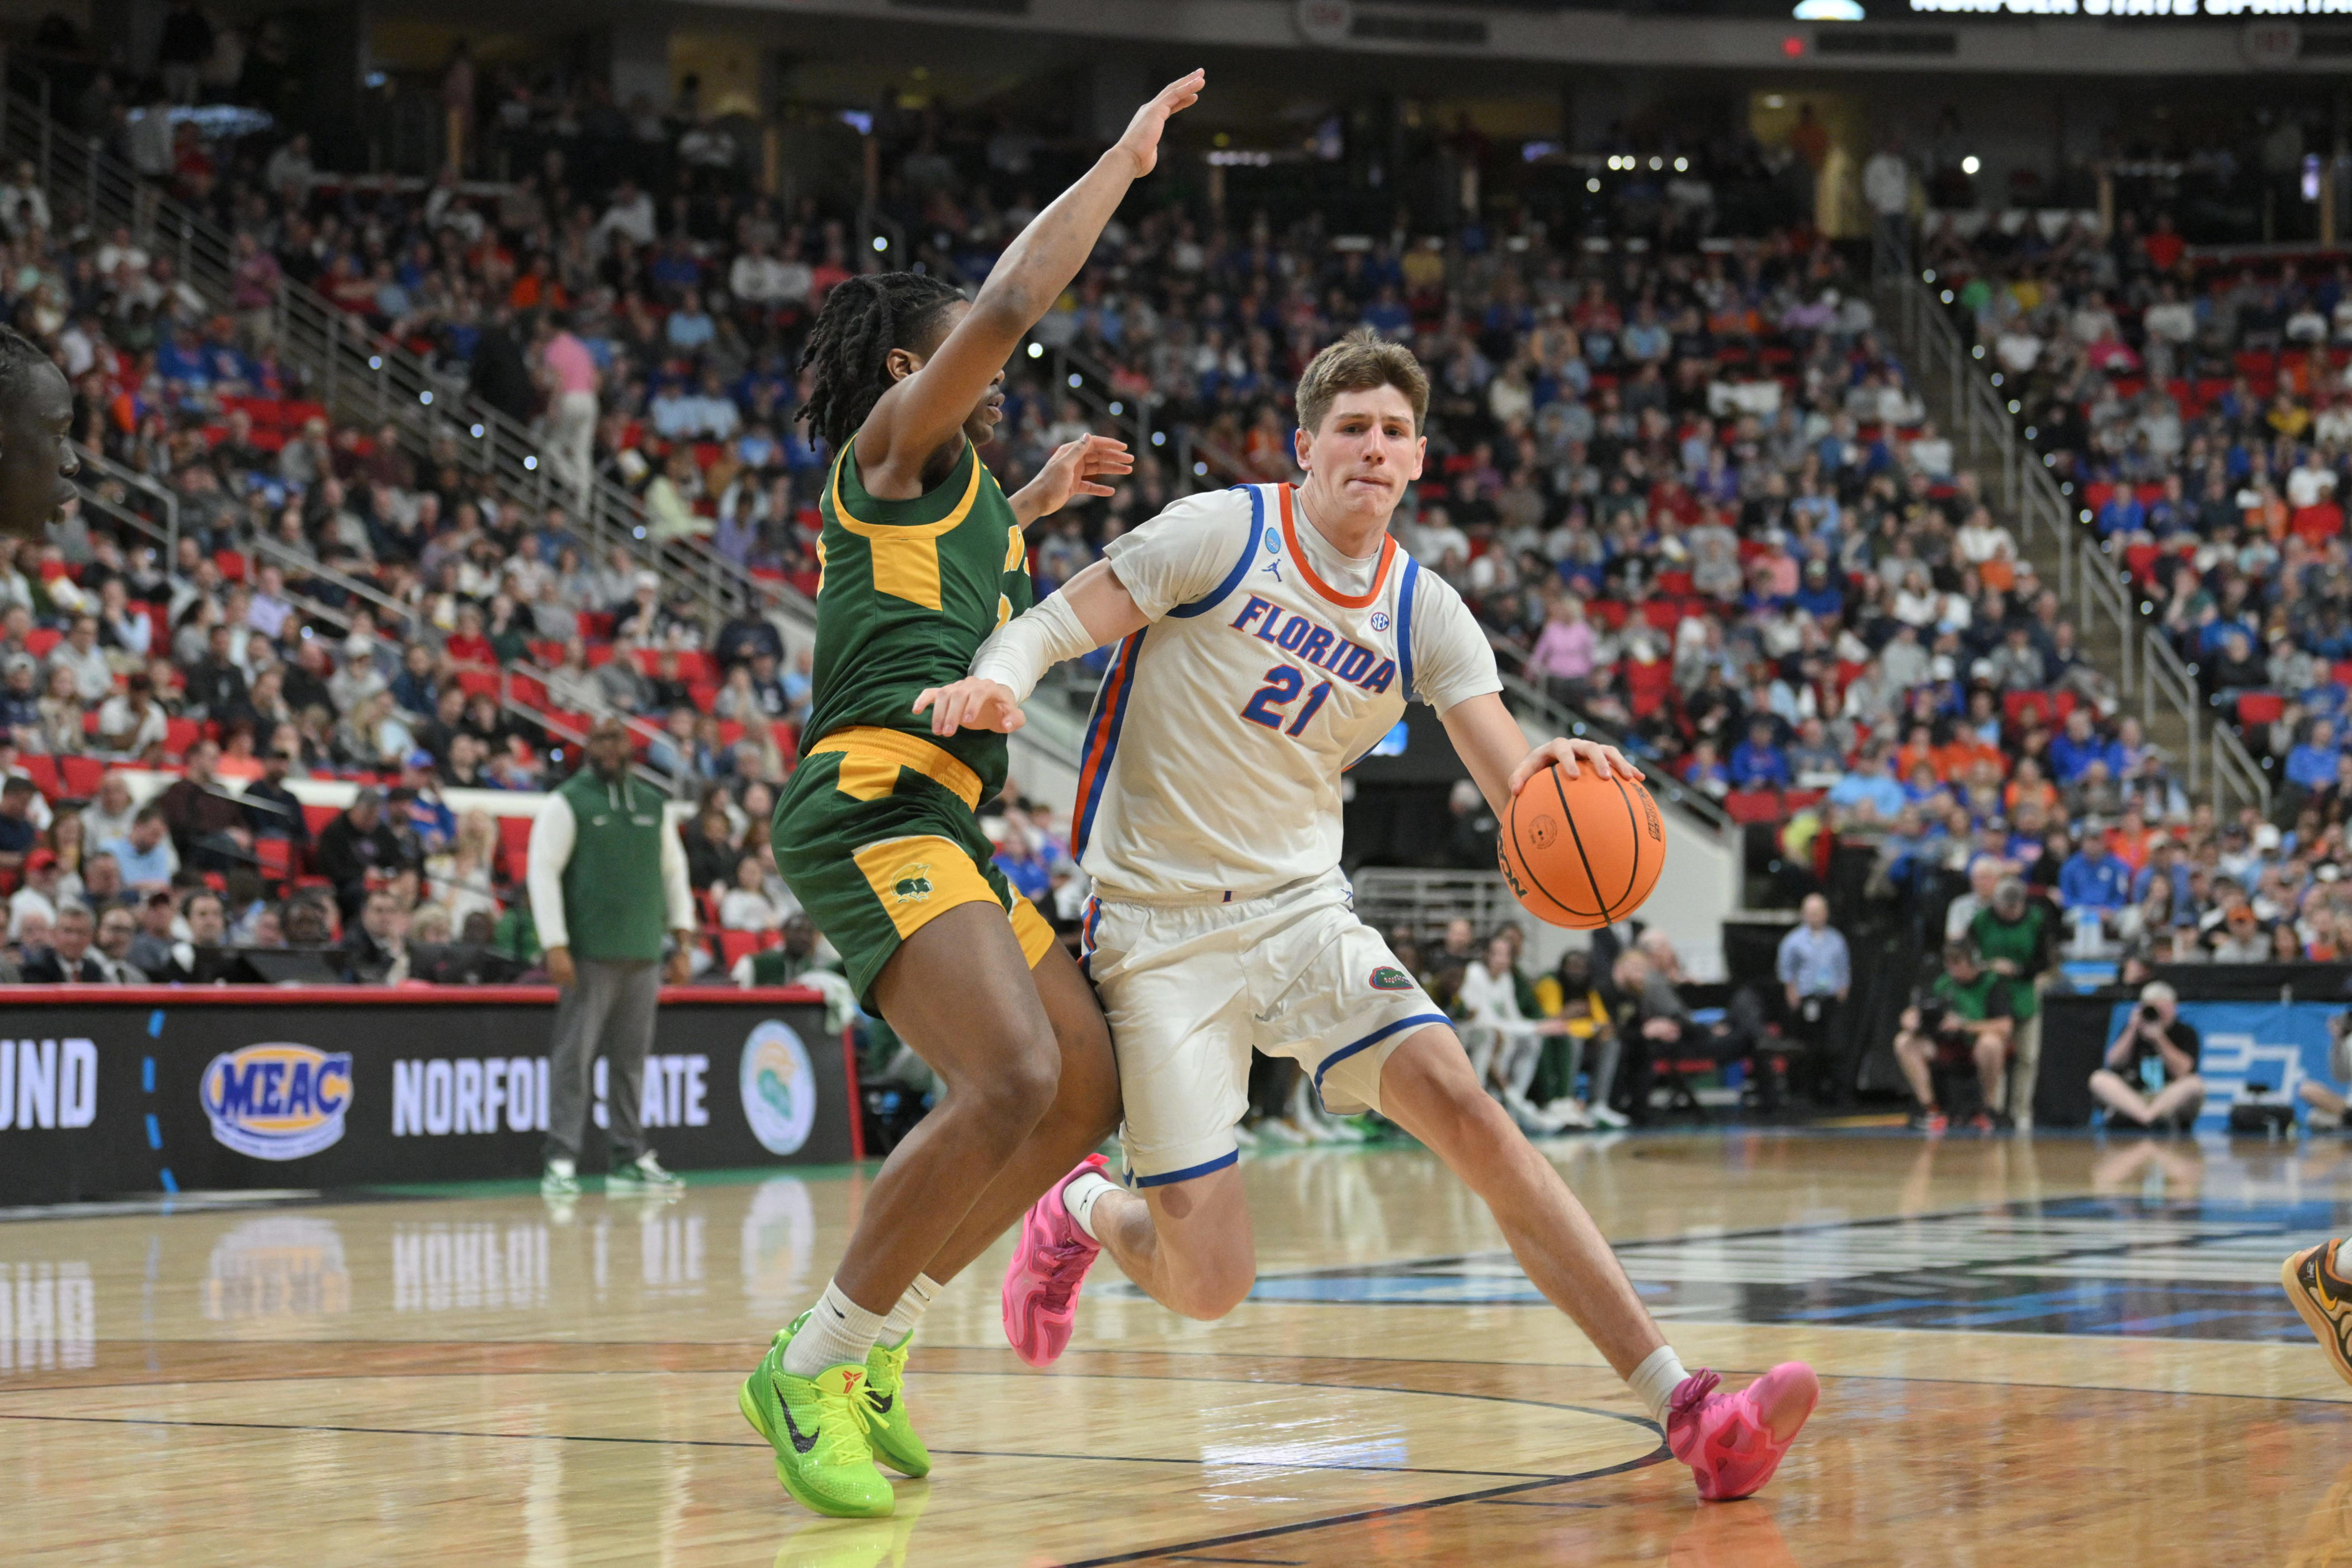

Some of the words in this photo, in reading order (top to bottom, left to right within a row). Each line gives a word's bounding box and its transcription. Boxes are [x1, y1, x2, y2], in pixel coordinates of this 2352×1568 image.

[1228, 593, 1396, 695] FLORIDA
[1372, 612, 1389, 631] SEC
[1240, 663, 1333, 738] 21
[220, 1060, 347, 1115] MEAC
[392, 1055, 551, 1136] NORFOL
[593, 1054, 710, 1130] SATE
